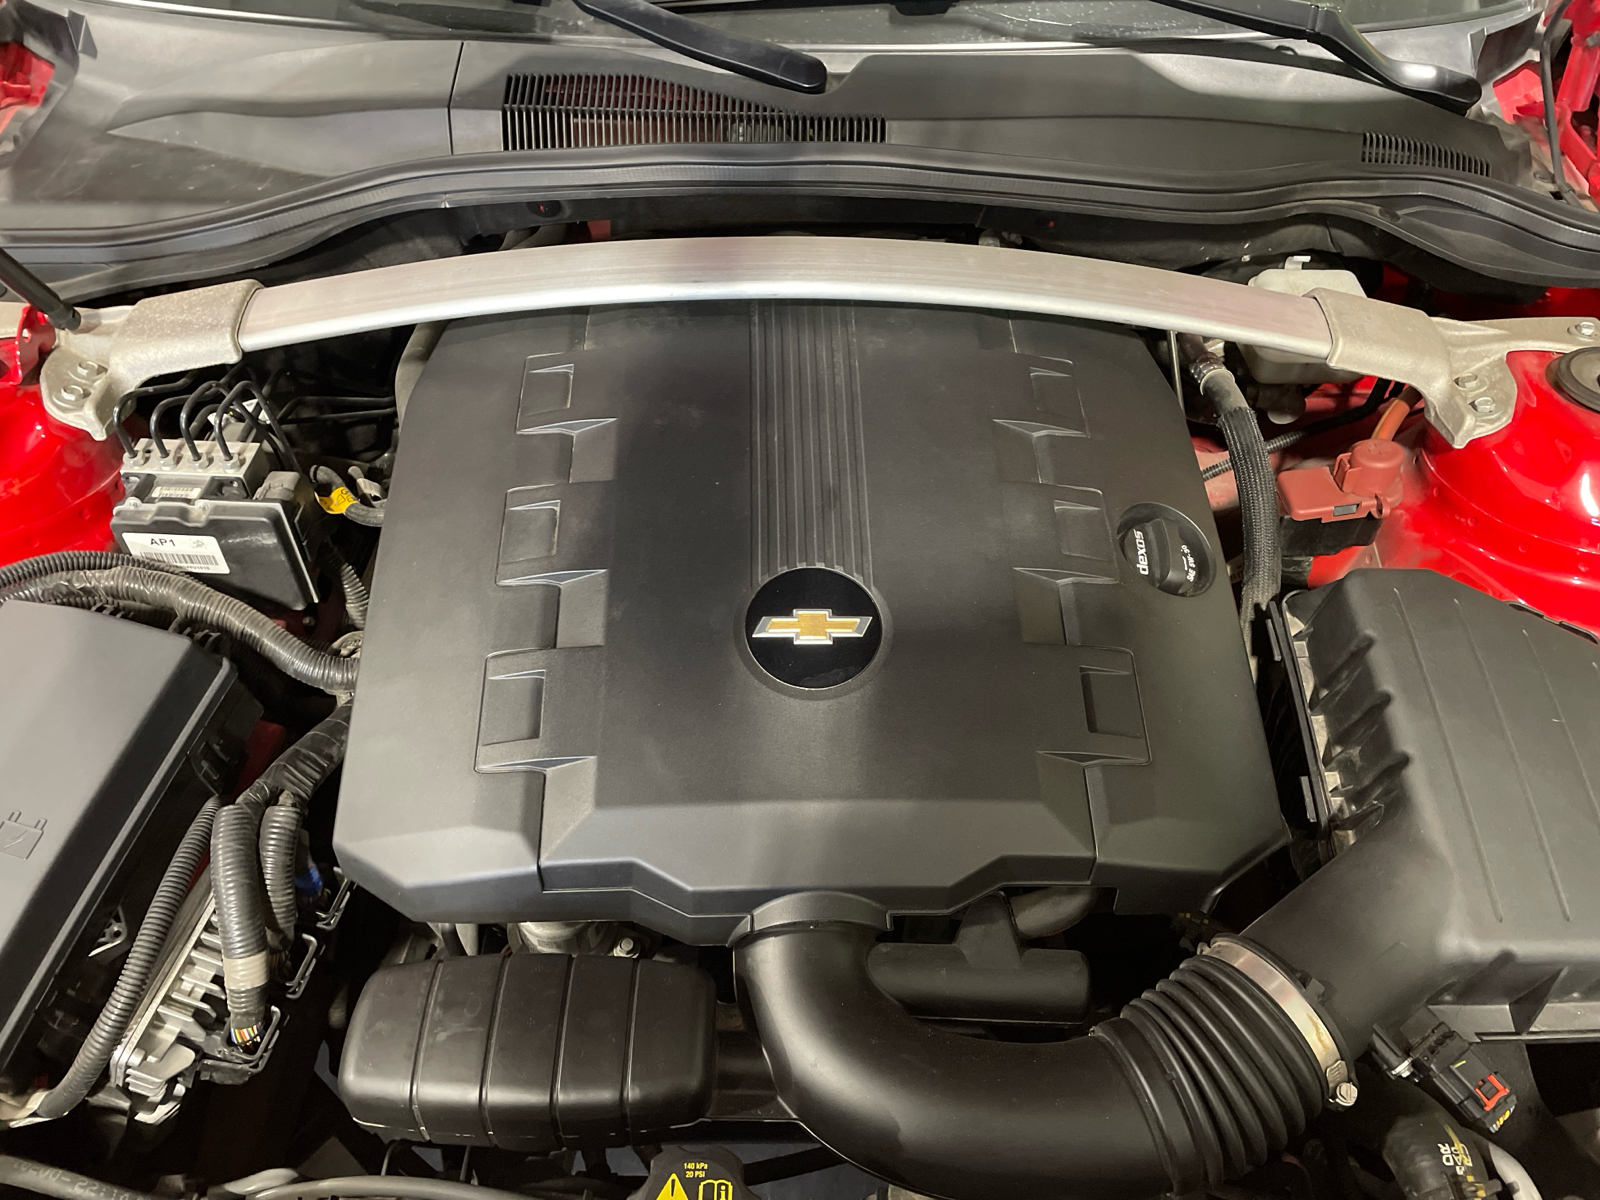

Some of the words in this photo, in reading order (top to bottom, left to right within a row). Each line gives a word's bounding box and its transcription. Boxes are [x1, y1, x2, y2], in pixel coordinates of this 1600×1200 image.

[150, 538, 176, 547] AP1
[1133, 529, 1149, 575] dexos
[1186, 568, 1196, 582] SAE
[683, 1162, 695, 1170] 140
[696, 1162, 708, 1170] kPa
